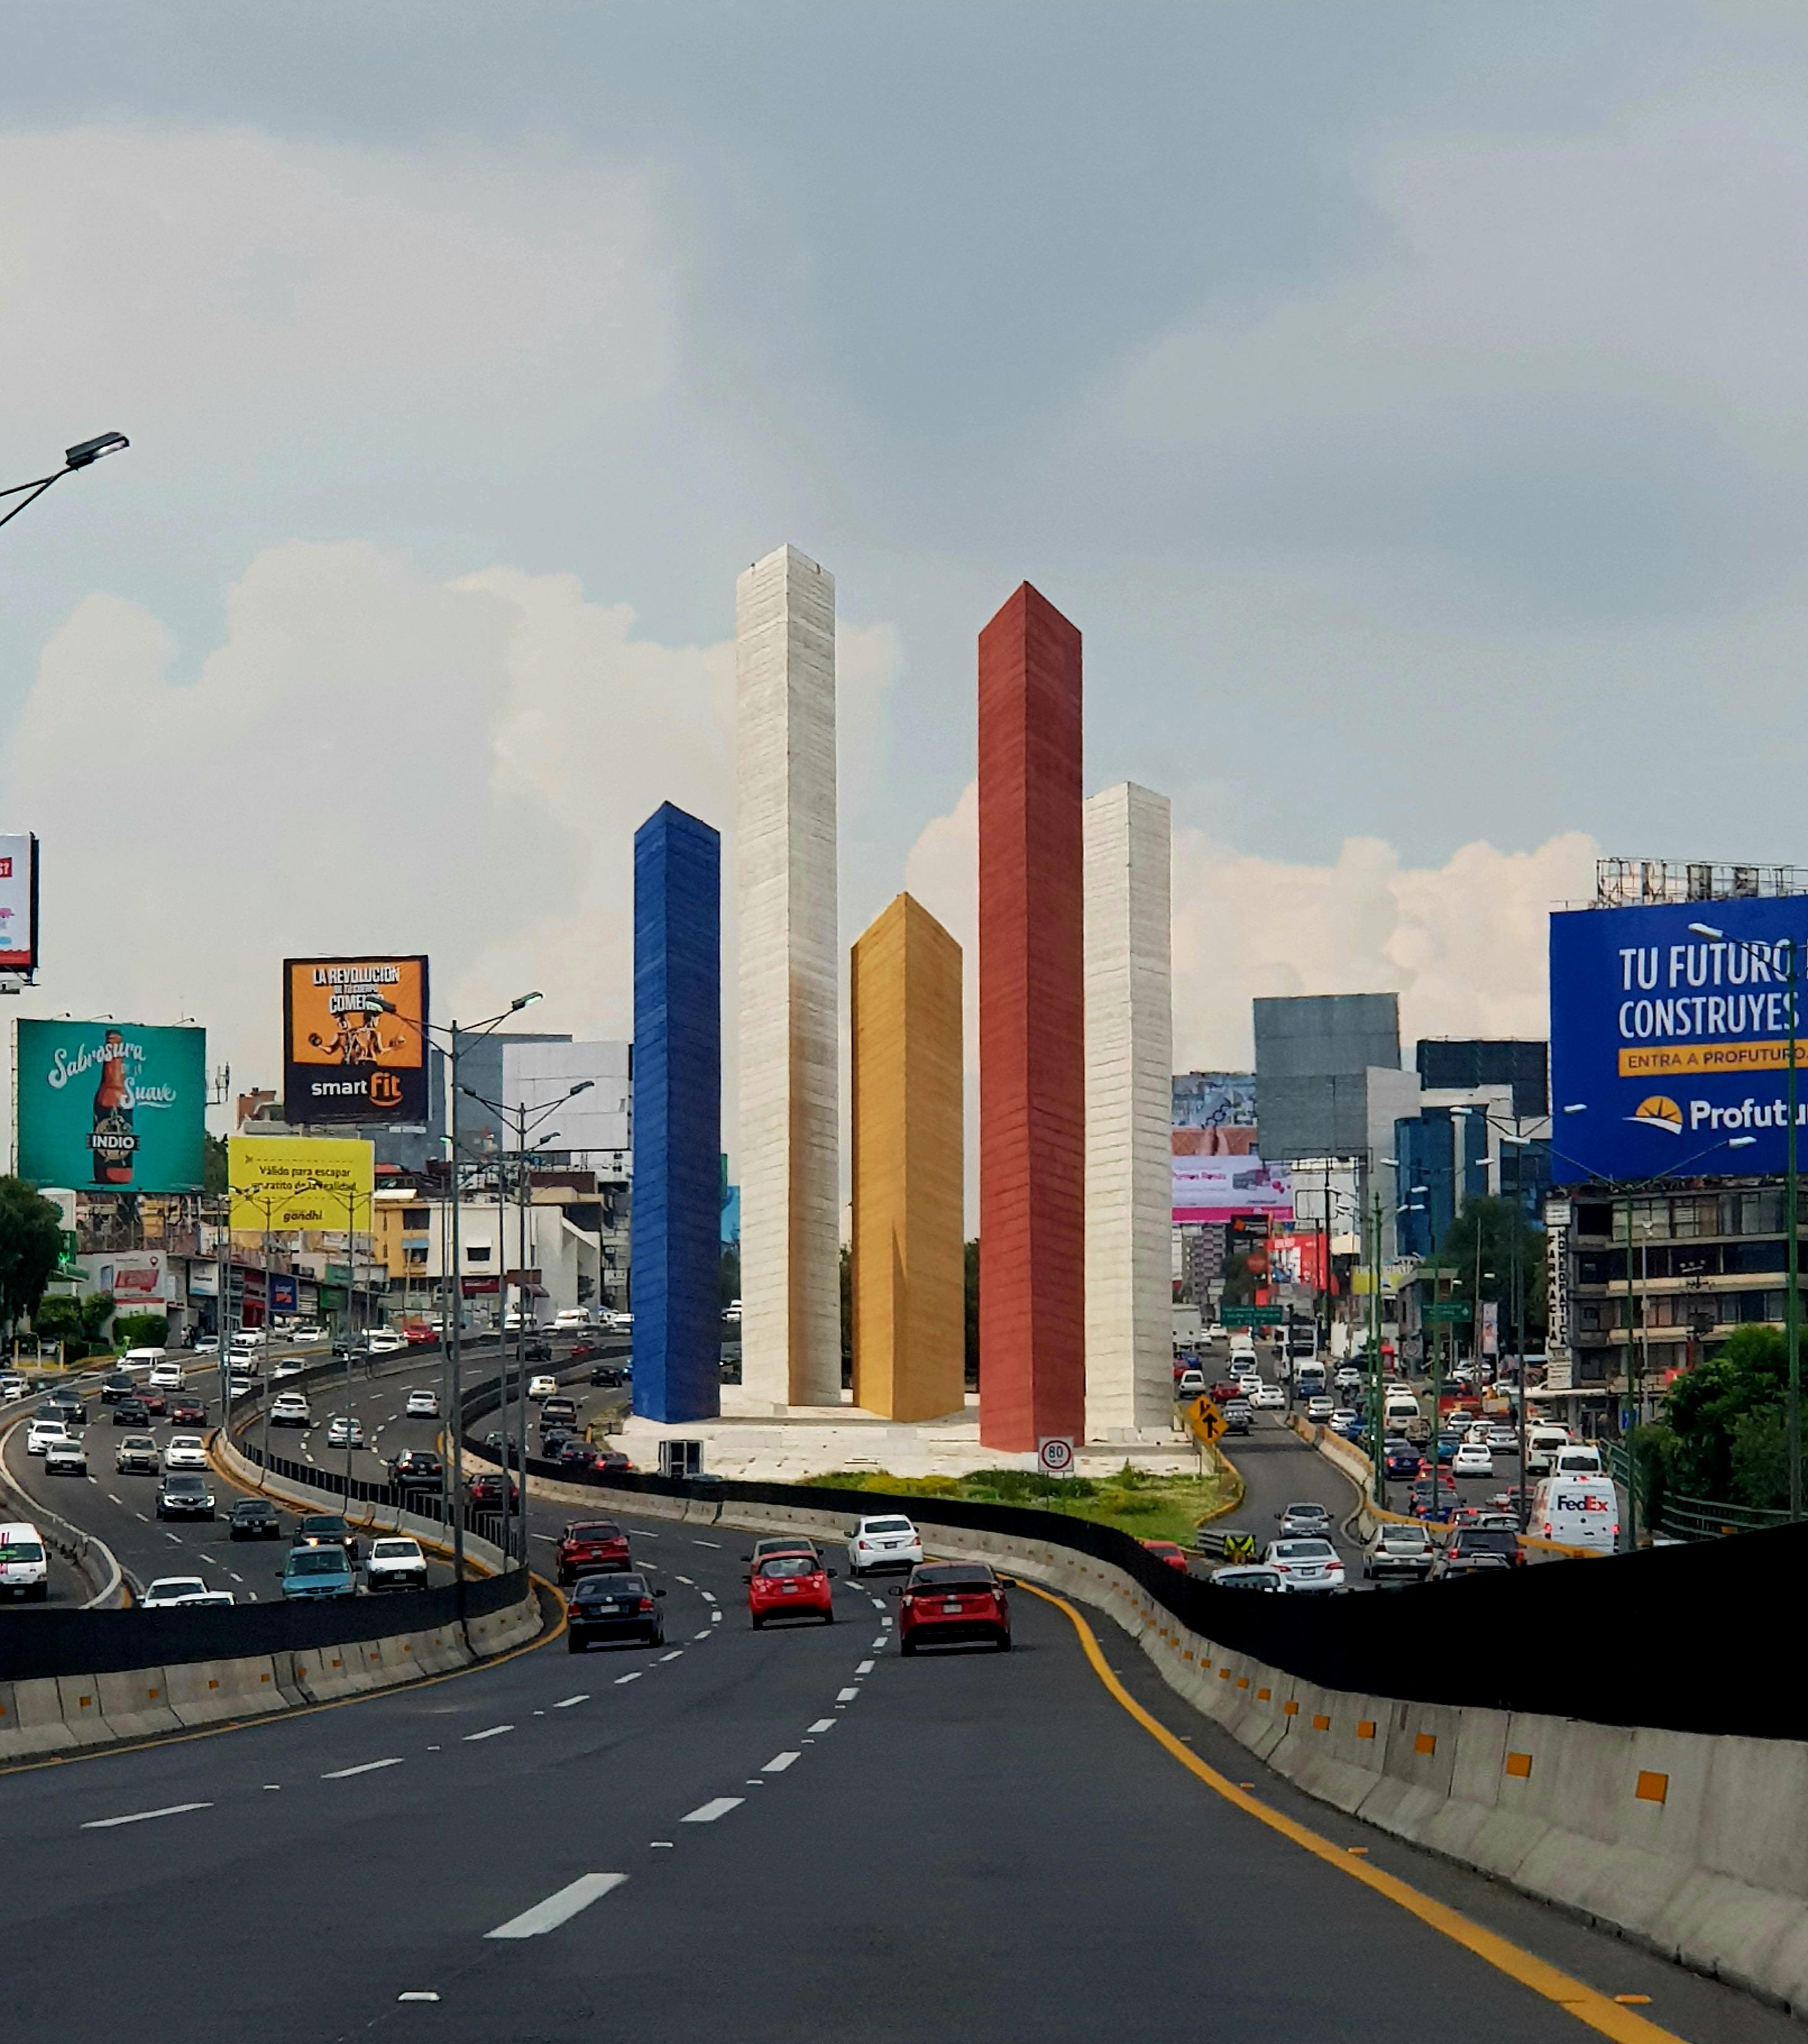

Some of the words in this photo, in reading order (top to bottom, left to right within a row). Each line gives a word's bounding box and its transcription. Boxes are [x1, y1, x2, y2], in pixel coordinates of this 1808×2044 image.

[1619, 946, 1659, 990] TU
[1669, 938, 1793, 988] FUTURO
[313, 968, 326, 984] LA
[1619, 992, 1800, 1039] CONSTRUYES
[48, 1042, 147, 1089] Sabrosura
[1628, 1054, 1682, 1068] ENTRA
[1687, 1053, 1698, 1065] A
[311, 1080, 368, 1096] smart
[371, 1072, 402, 1097] fit
[118, 1077, 176, 1109] Suave
[92, 1135, 135, 1149] INDIO
[259, 1165, 290, 1176] Válido
[292, 1167, 313, 1178] para
[315, 1167, 352, 1179] escapar
[264, 1181, 293, 1190] ratito
[283, 1210, 323, 1223] gandhi
[1548, 1235, 1558, 1340] FARMACIA
[1049, 1445, 1063, 1458] 80
[1557, 1495, 1609, 1511] FedEx
